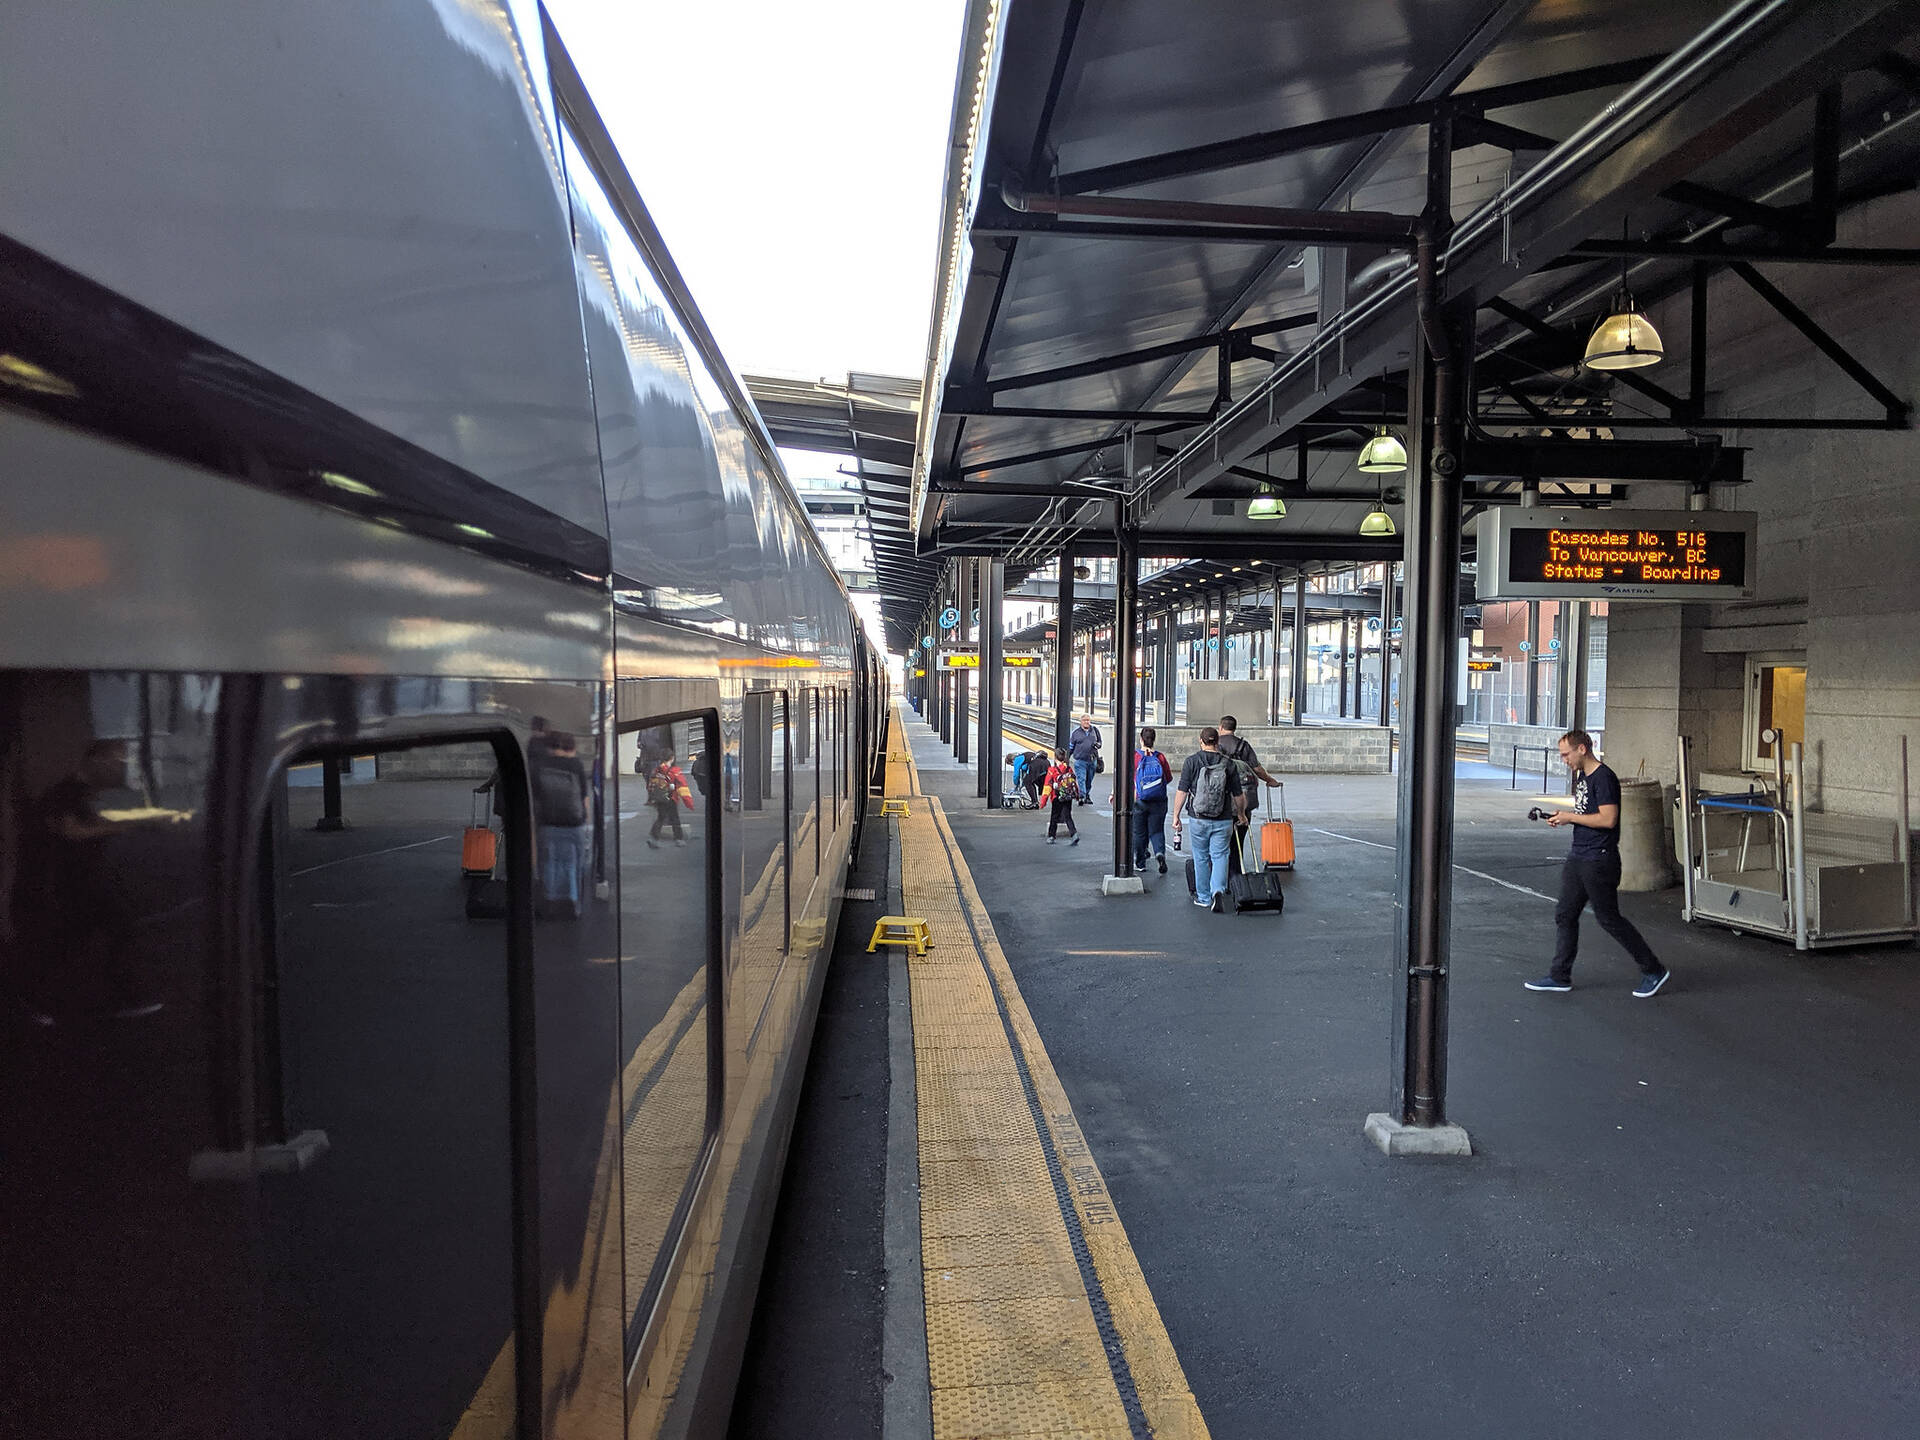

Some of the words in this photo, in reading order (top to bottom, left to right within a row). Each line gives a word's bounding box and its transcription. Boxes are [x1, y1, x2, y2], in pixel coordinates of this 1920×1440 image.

[1550, 529, 1630, 545] Cascades
[1638, 530, 1665, 546] No.
[1677, 531, 1707, 547] 516
[1549, 546, 1570, 561] To
[1579, 546, 1675, 563] Vancouver,
[1686, 548, 1707, 564] BC
[1544, 562, 1604, 578] Status
[1642, 564, 1721, 580] Boarding
[948, 611, 955, 621] 5
[1082, 1201, 1115, 1225] STAY
